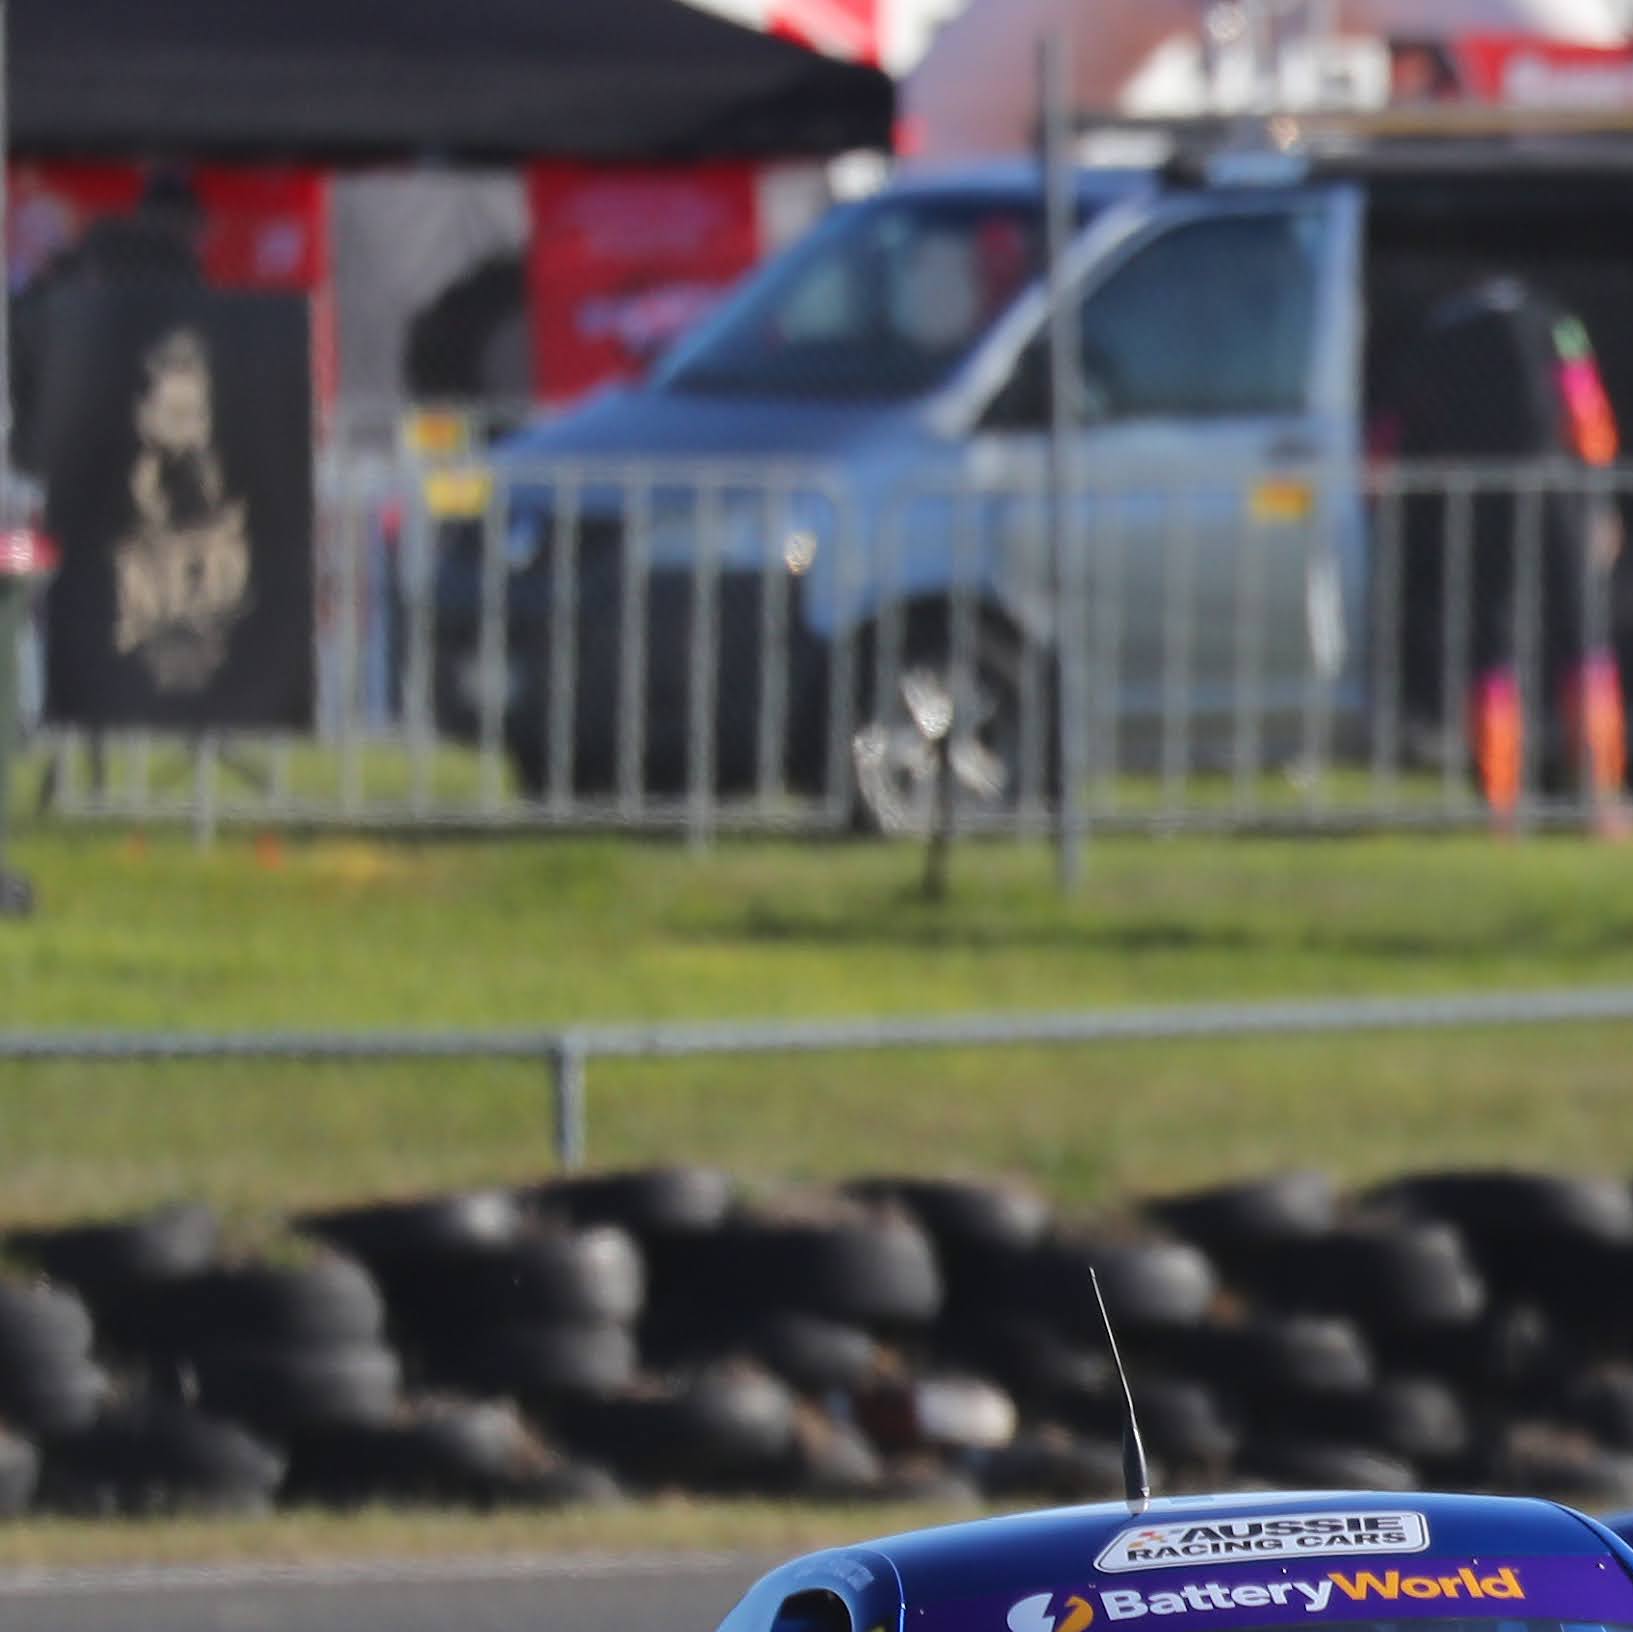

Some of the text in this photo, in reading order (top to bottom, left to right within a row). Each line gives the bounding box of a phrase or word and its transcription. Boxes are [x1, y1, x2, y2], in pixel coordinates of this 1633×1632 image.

[1179, 1515, 1406, 1543] AUSSIE
[1127, 1530, 1408, 1562] RACING CARS
